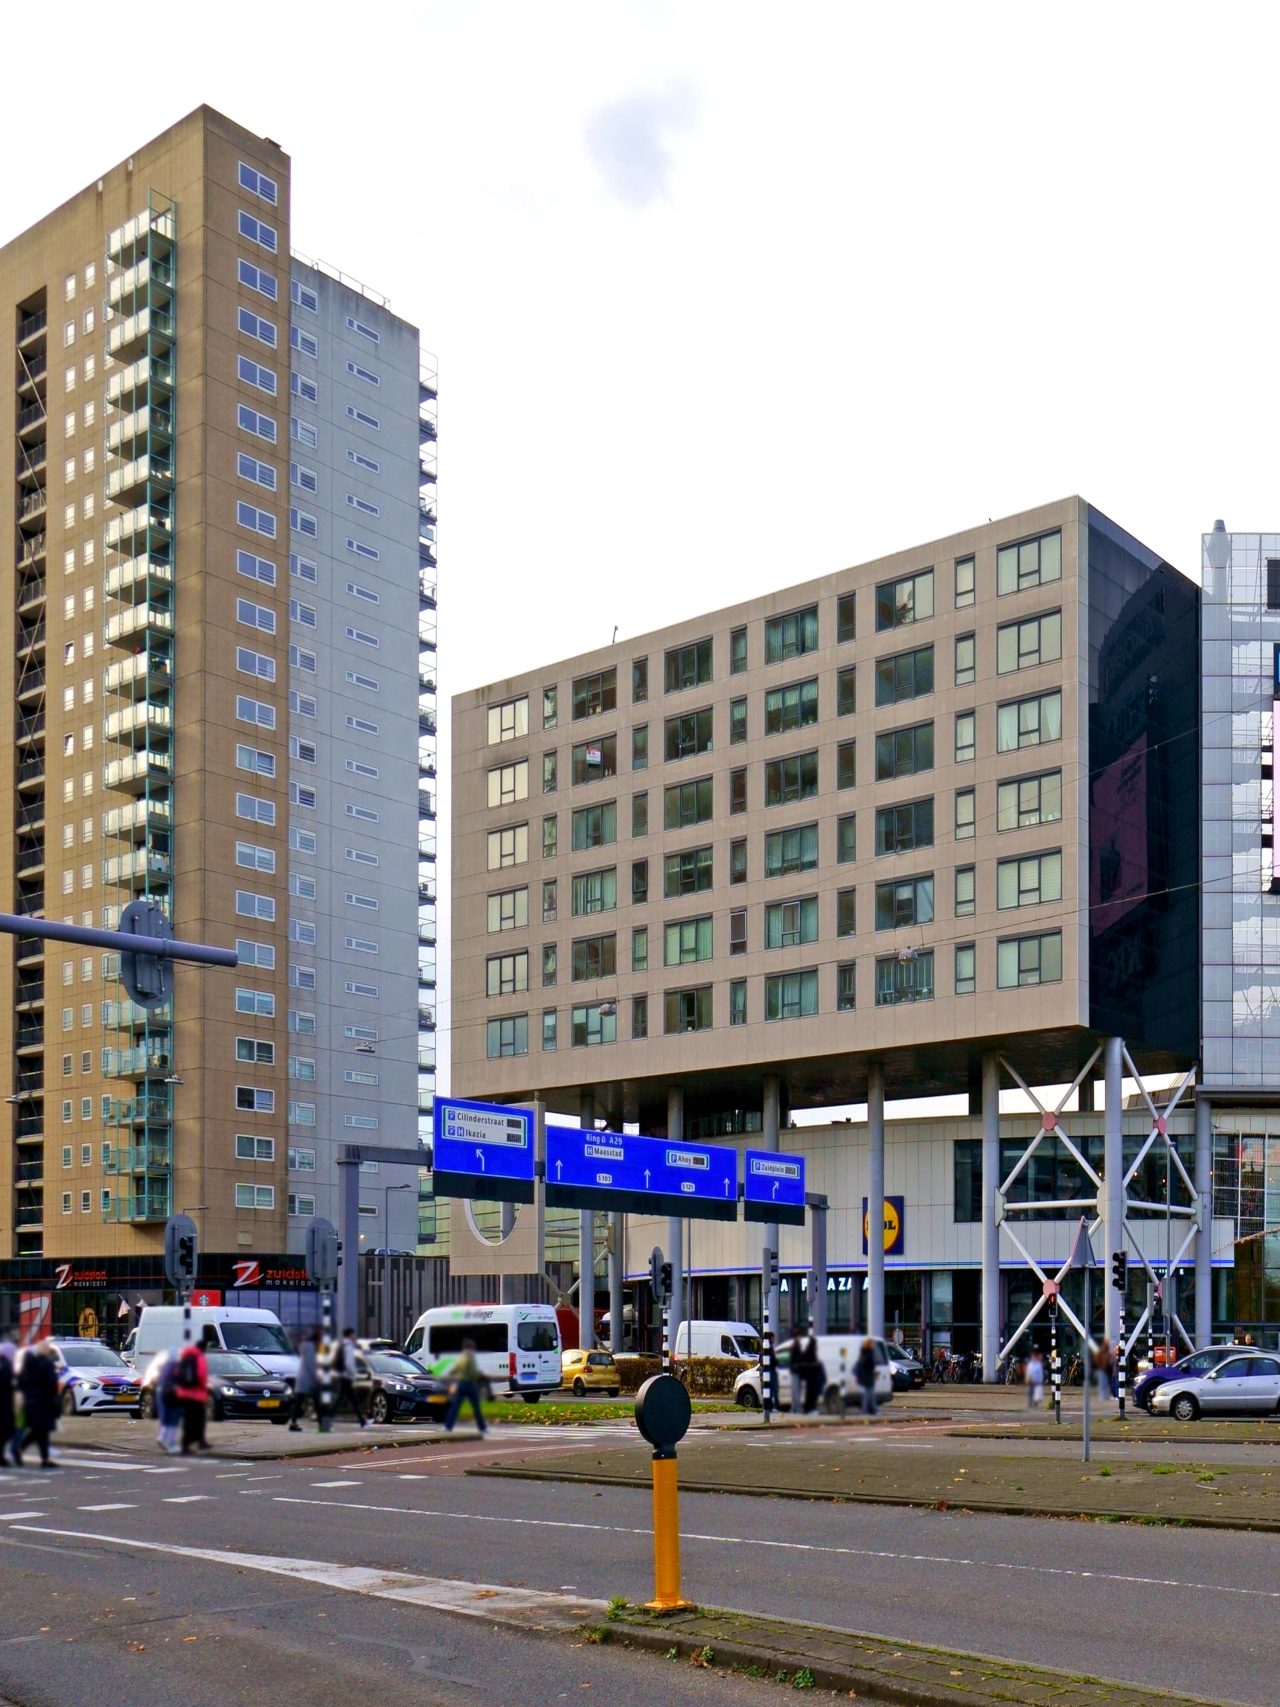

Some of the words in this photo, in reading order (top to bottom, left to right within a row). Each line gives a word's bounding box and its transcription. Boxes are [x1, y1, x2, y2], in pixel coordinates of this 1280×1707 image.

[457, 1112, 504, 1126] Cilinderstraat
[466, 1129, 486, 1139] Ikazia
[586, 1133, 601, 1144] Ring
[609, 1137, 623, 1145] A29
[594, 1147, 622, 1157] Maasstad
[677, 1155, 692, 1165] Ahoy
[801, 1277, 853, 1292] PAZA
